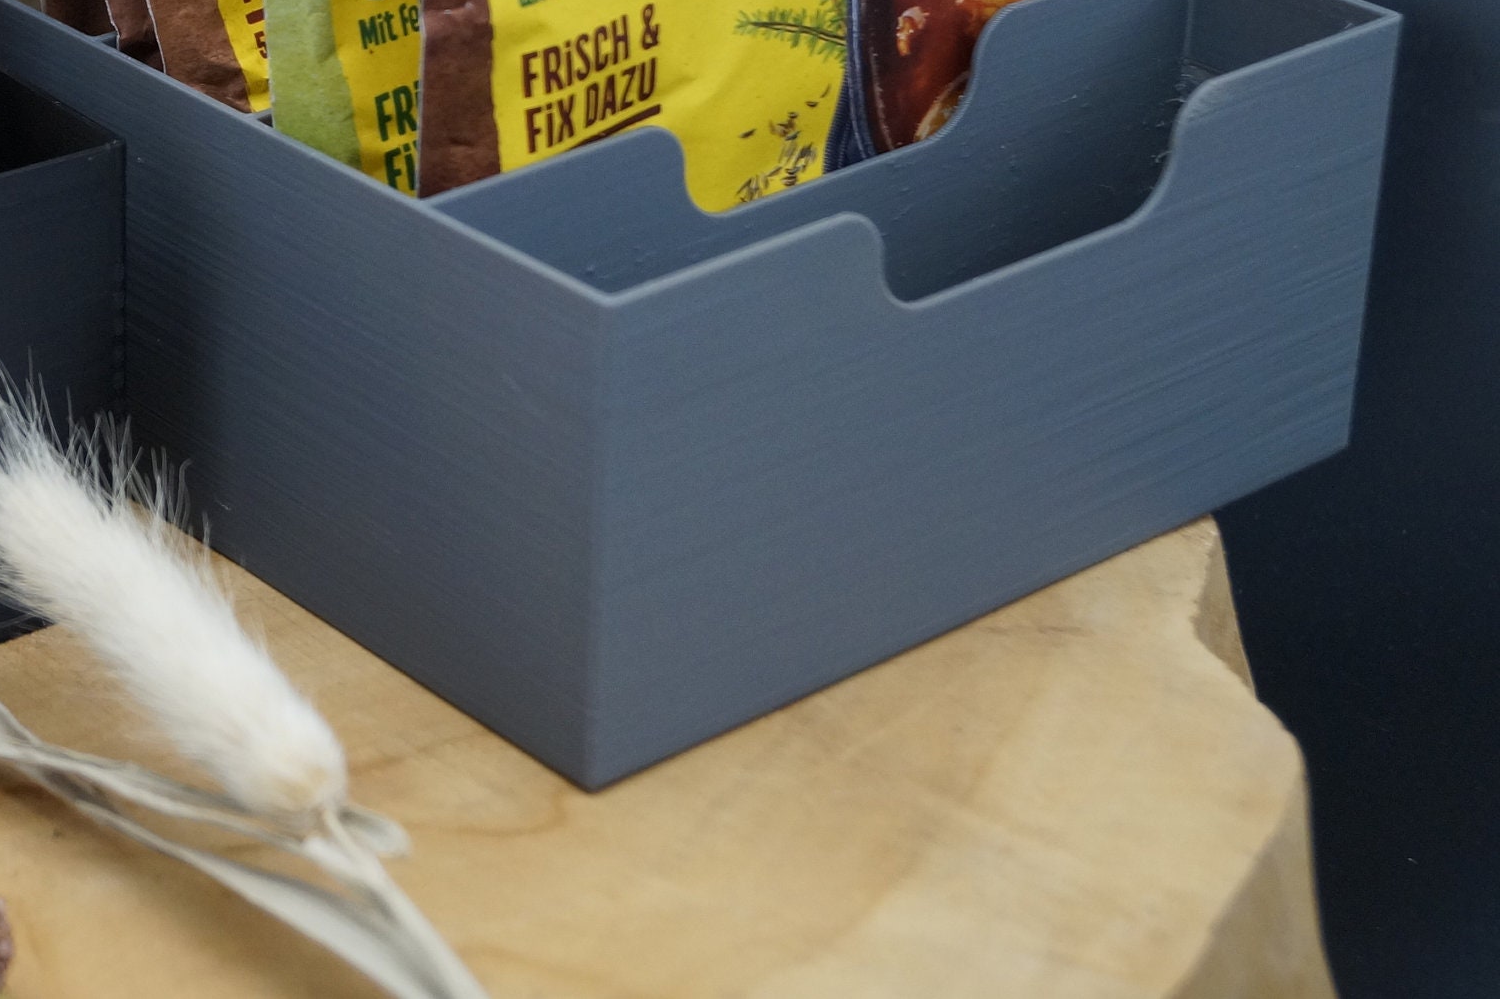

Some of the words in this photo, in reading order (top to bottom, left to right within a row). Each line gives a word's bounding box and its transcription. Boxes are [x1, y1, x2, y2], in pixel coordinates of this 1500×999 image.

[358, 11, 398, 50] Mit
[641, 3, 660, 50] &
[583, 57, 658, 129] DAZU
